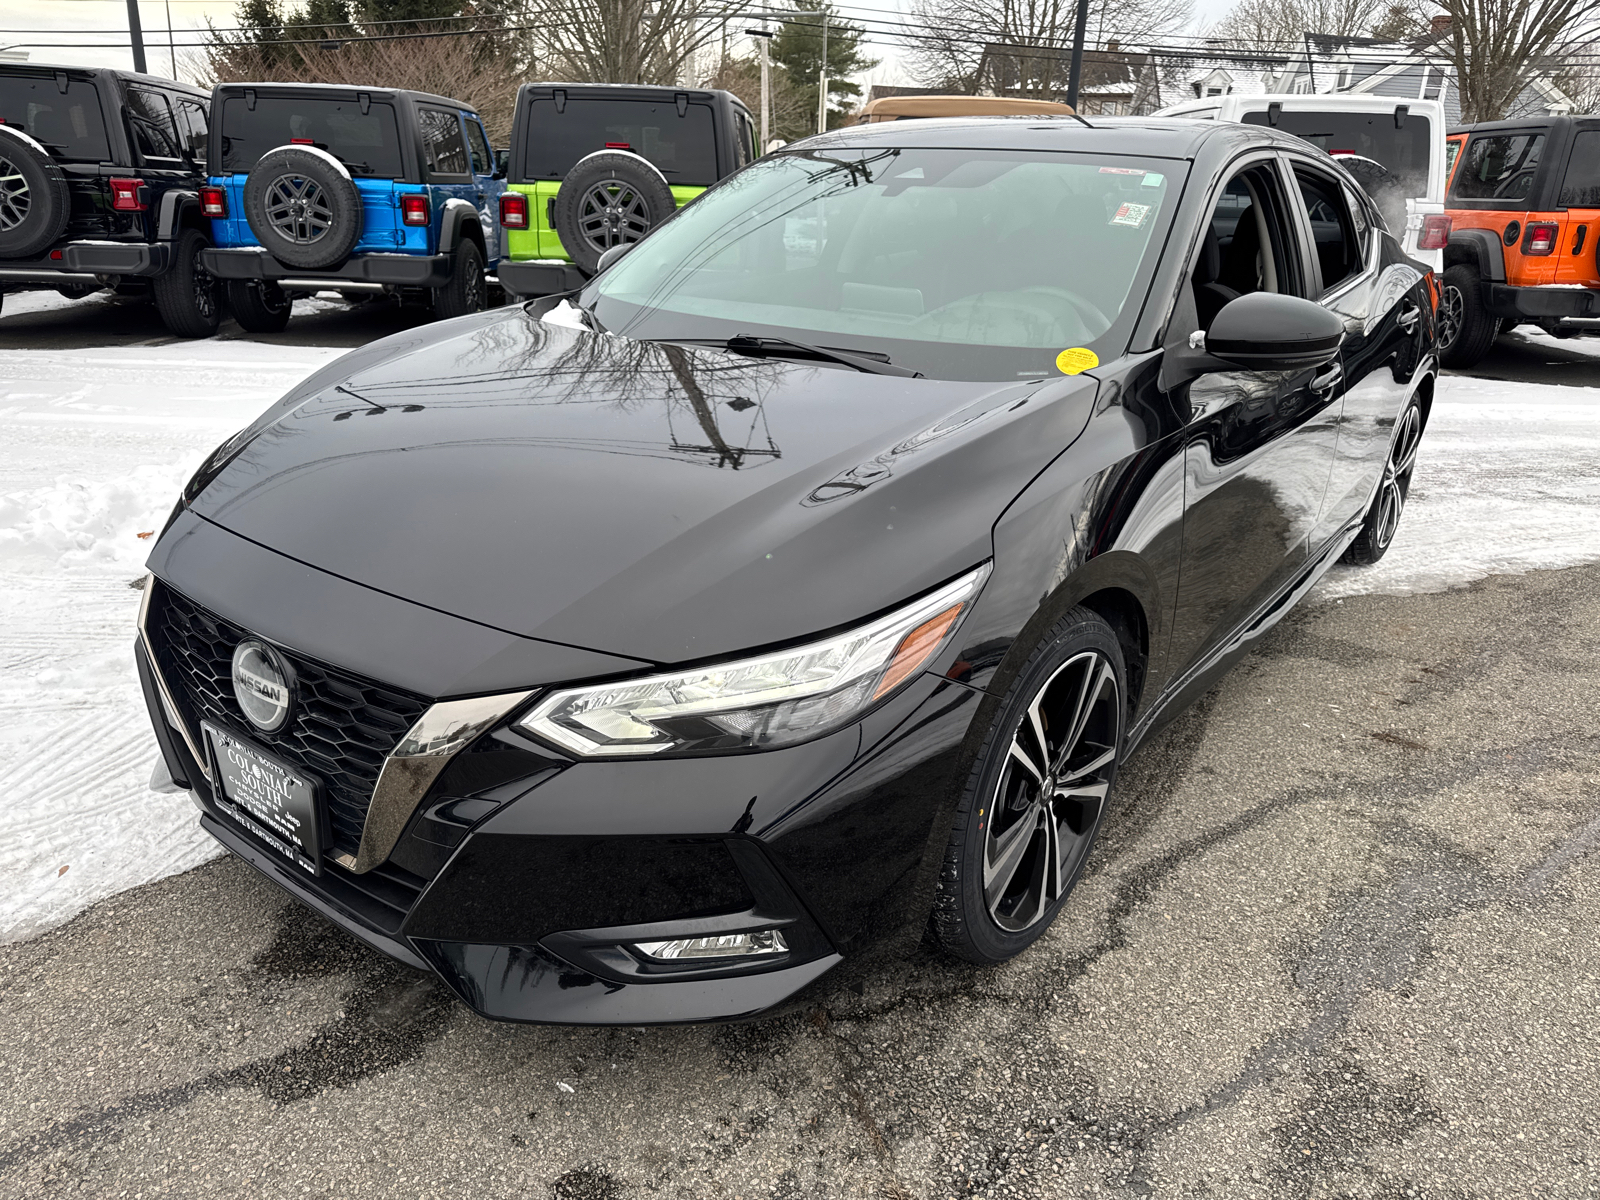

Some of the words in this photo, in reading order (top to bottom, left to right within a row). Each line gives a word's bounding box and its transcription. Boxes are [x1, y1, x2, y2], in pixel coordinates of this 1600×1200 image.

[240, 672, 280, 702] NISSAN
[228, 775, 279, 812] CHRYSLER
[285, 811, 301, 827] Jeep
[241, 770, 282, 807] SOUTH
[237, 788, 268, 813] DODGE
[275, 814, 295, 832] RAM
[285, 849, 294, 860] MA
[292, 835, 302, 847] MA
